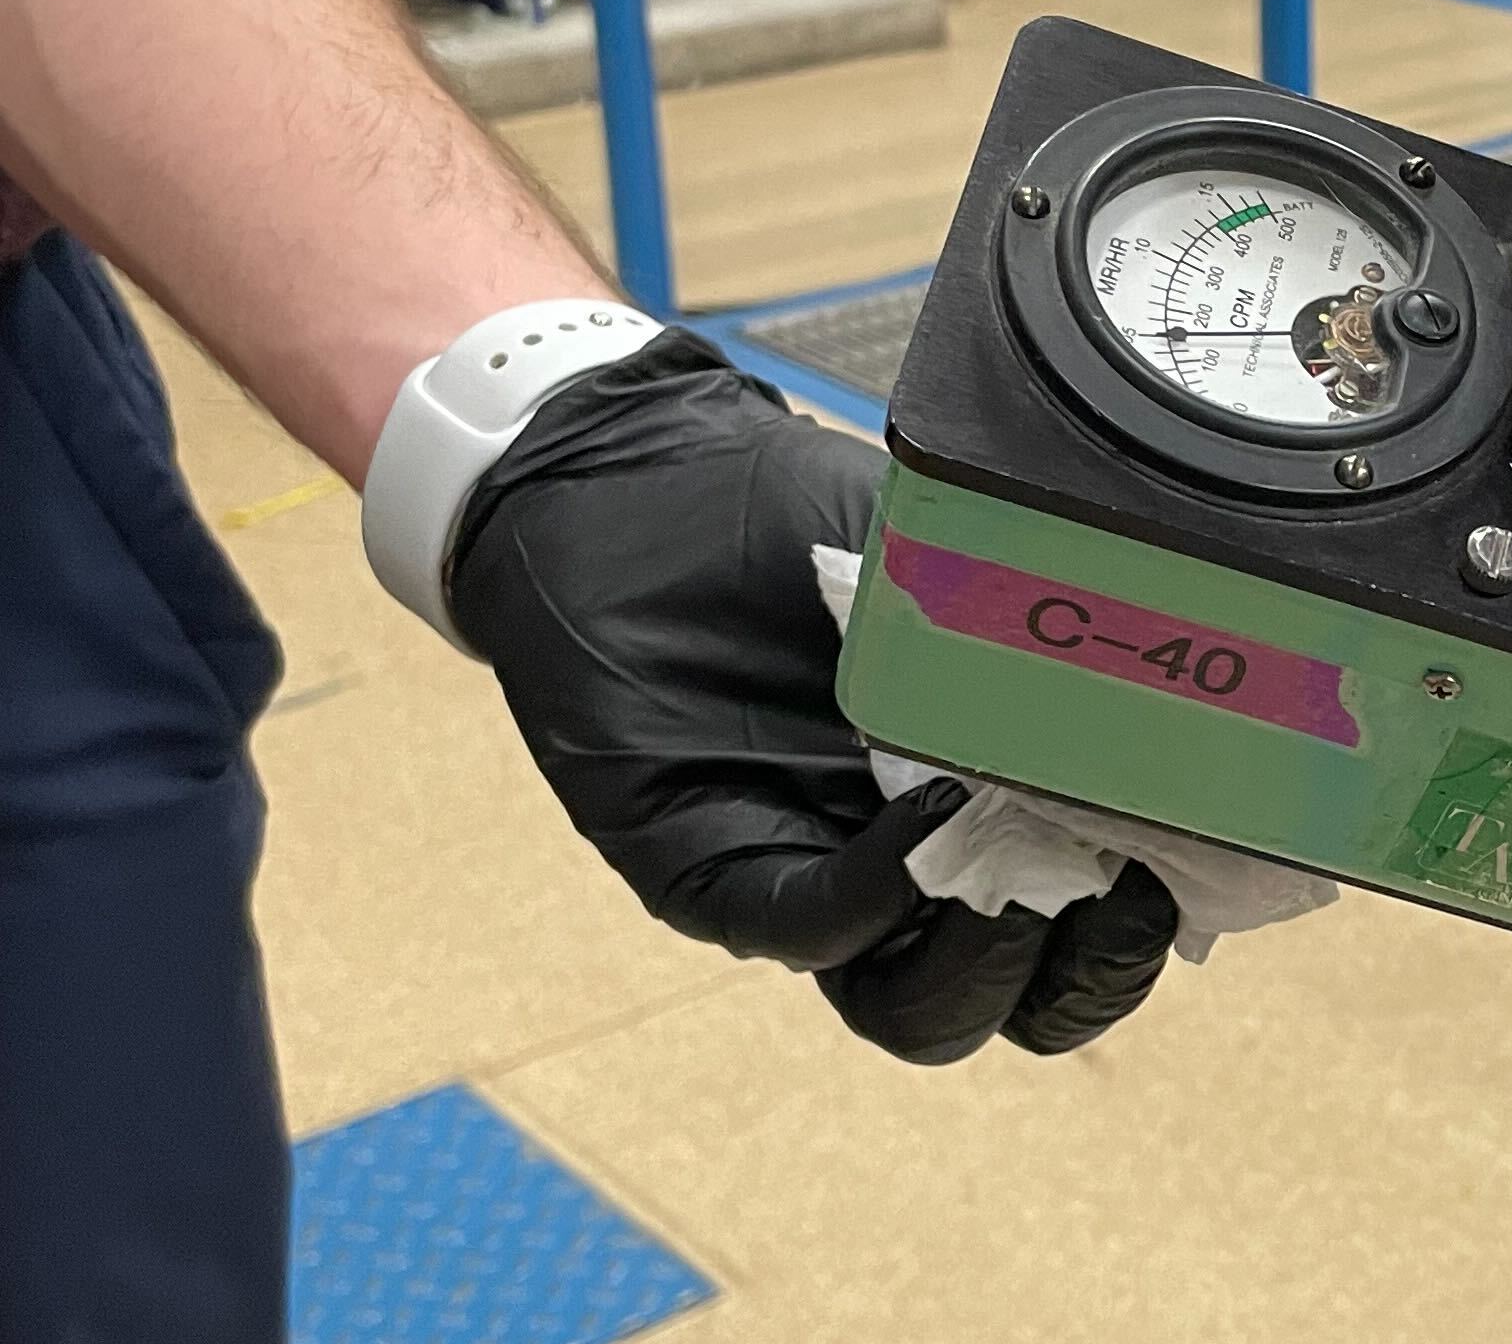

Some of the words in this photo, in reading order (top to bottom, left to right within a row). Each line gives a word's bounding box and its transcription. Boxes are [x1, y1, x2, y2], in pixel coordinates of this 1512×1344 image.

[1278, 217, 1297, 243] 500
[1233, 233, 1253, 258] 400
[1097, 236, 1130, 296] MR/HR
[1205, 266, 1225, 291] 300
[1259, 255, 1284, 320] ASSOCIATES
[1193, 303, 1213, 329] 200
[1229, 288, 1256, 329] CPM
[1202, 348, 1221, 372] 100
[1026, 597, 1248, 696] C-40
